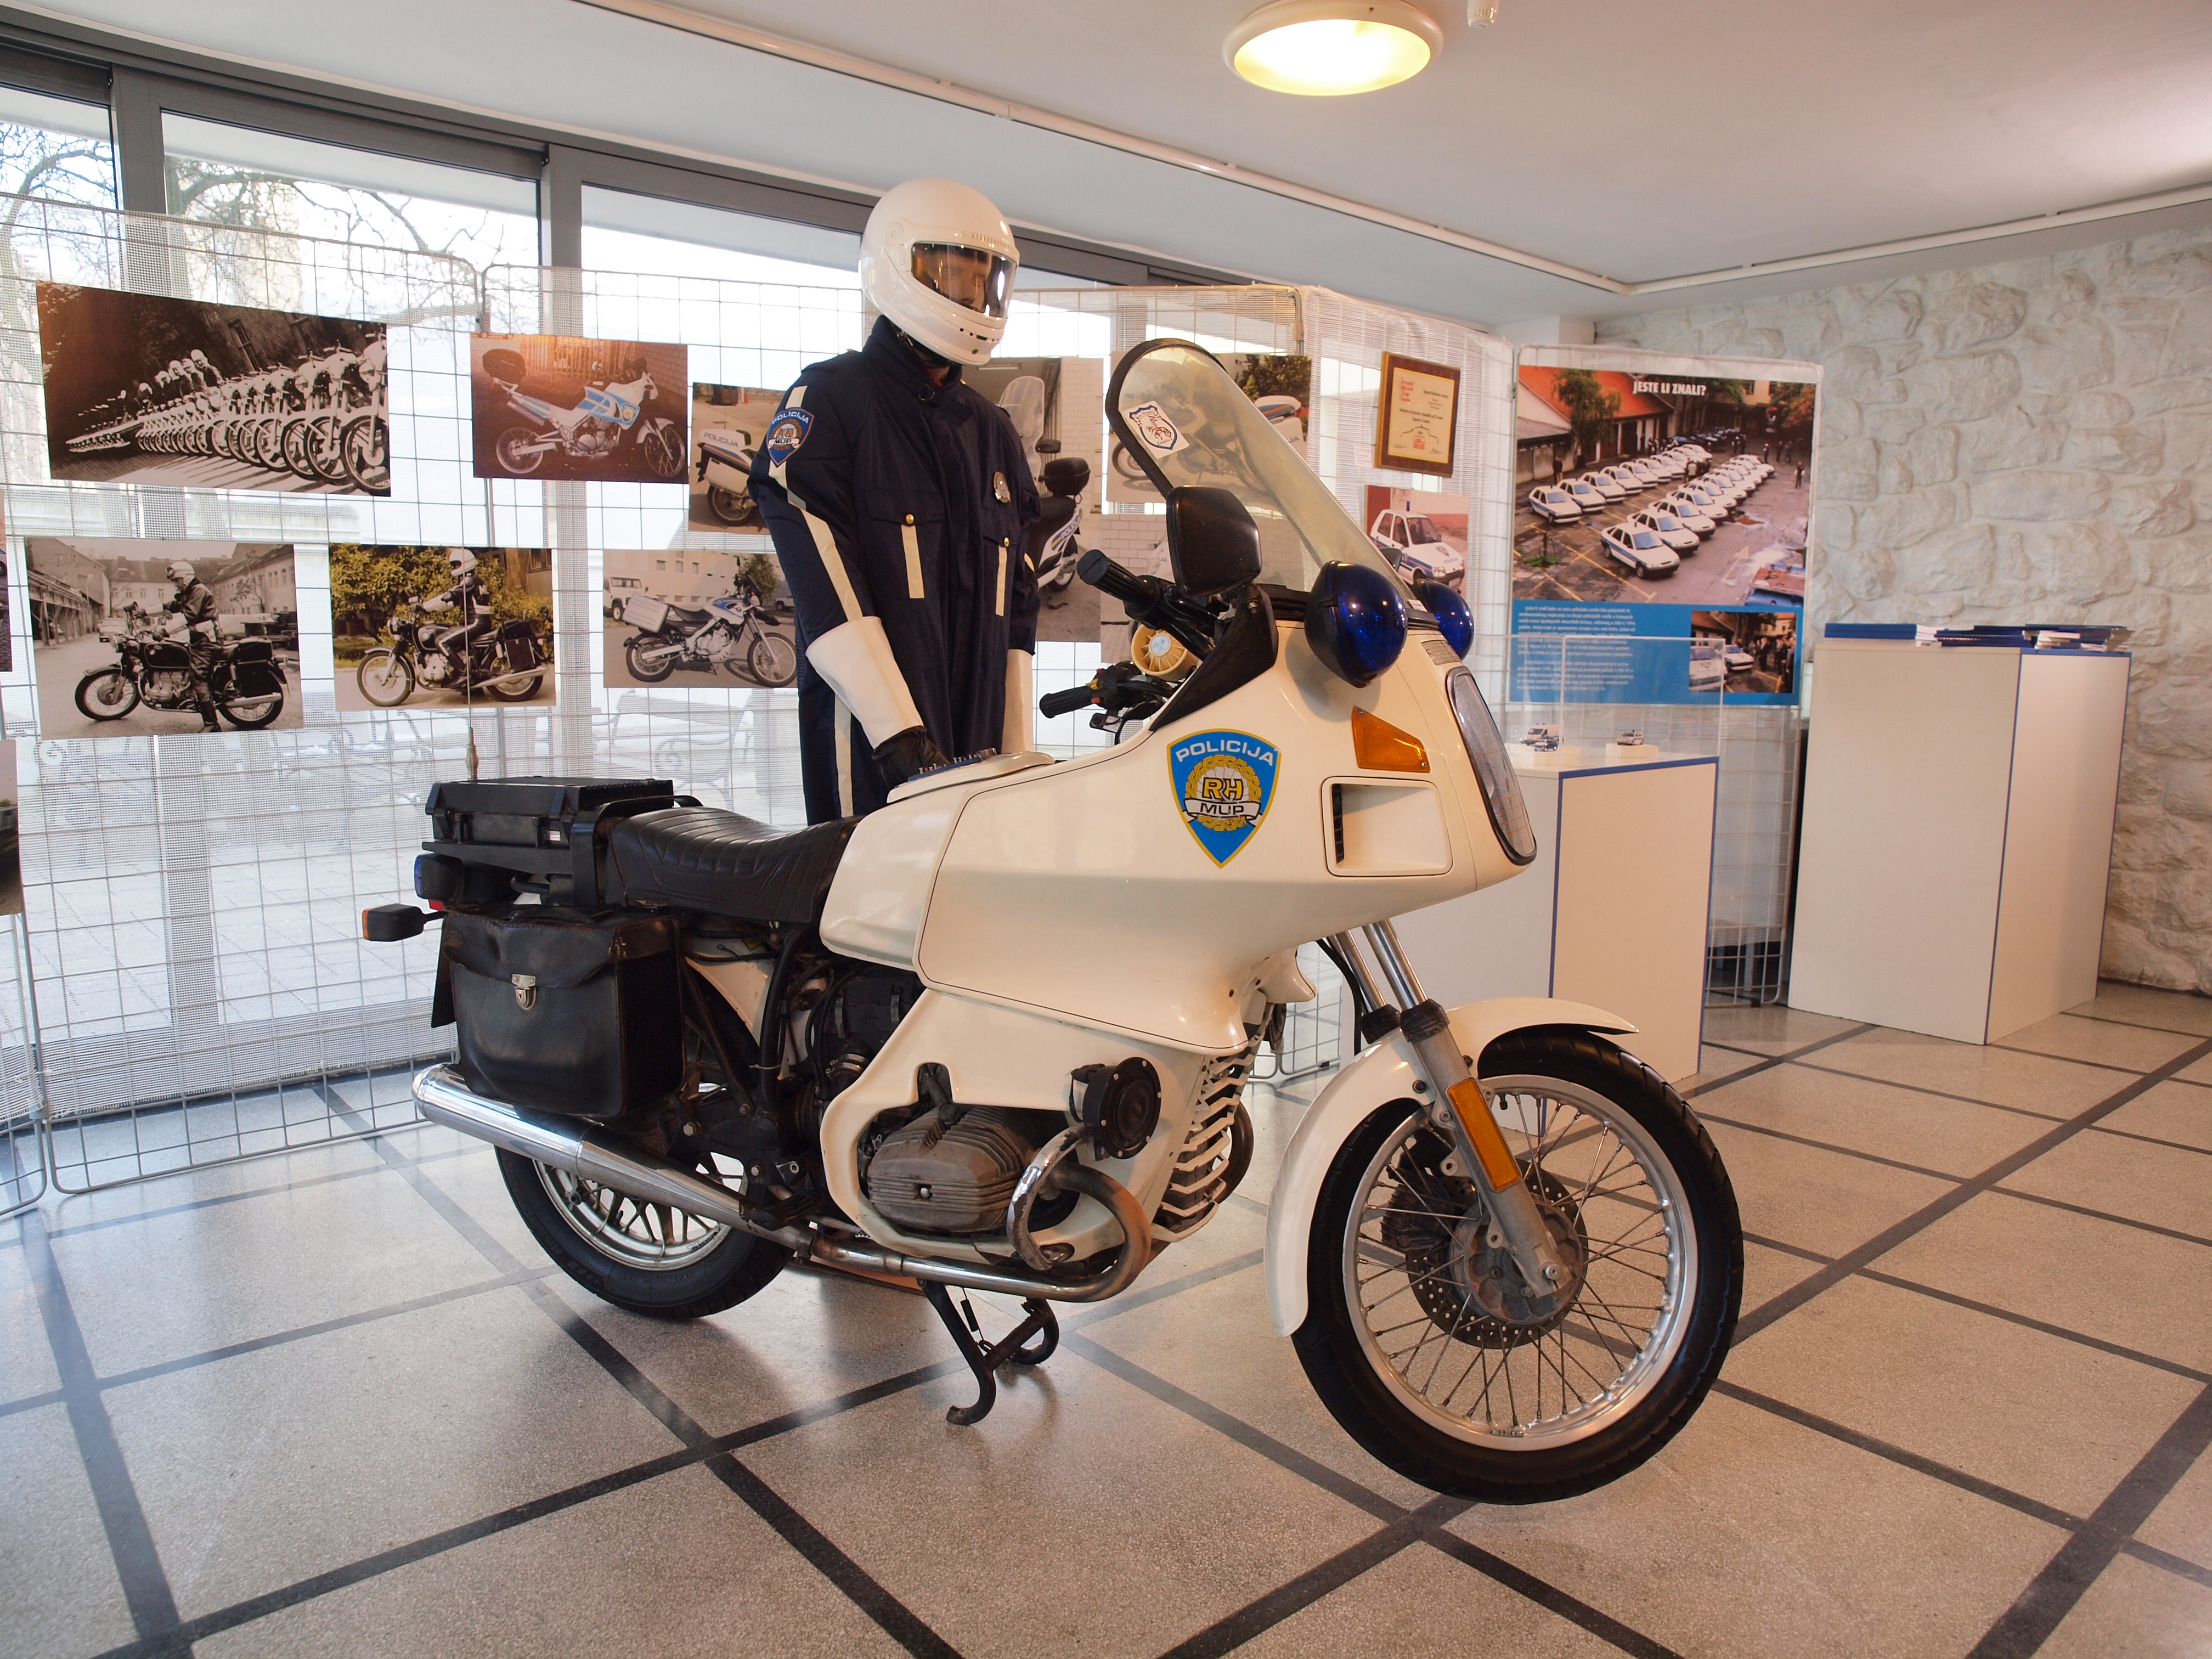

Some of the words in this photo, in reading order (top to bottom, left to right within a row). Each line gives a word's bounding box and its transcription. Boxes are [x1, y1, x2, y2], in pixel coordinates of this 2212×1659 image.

[1633, 381, 1658, 394] JESTE
[1660, 382, 1671, 393] LI
[1672, 383, 1707, 396] ZNALI?
[772, 411, 809, 425] POLICIJA
[704, 432, 738, 447] POLICIJA
[1176, 740, 1273, 766] POLICIJA
[1201, 777, 1244, 801] RH
[1200, 803, 1244, 816] MUP
